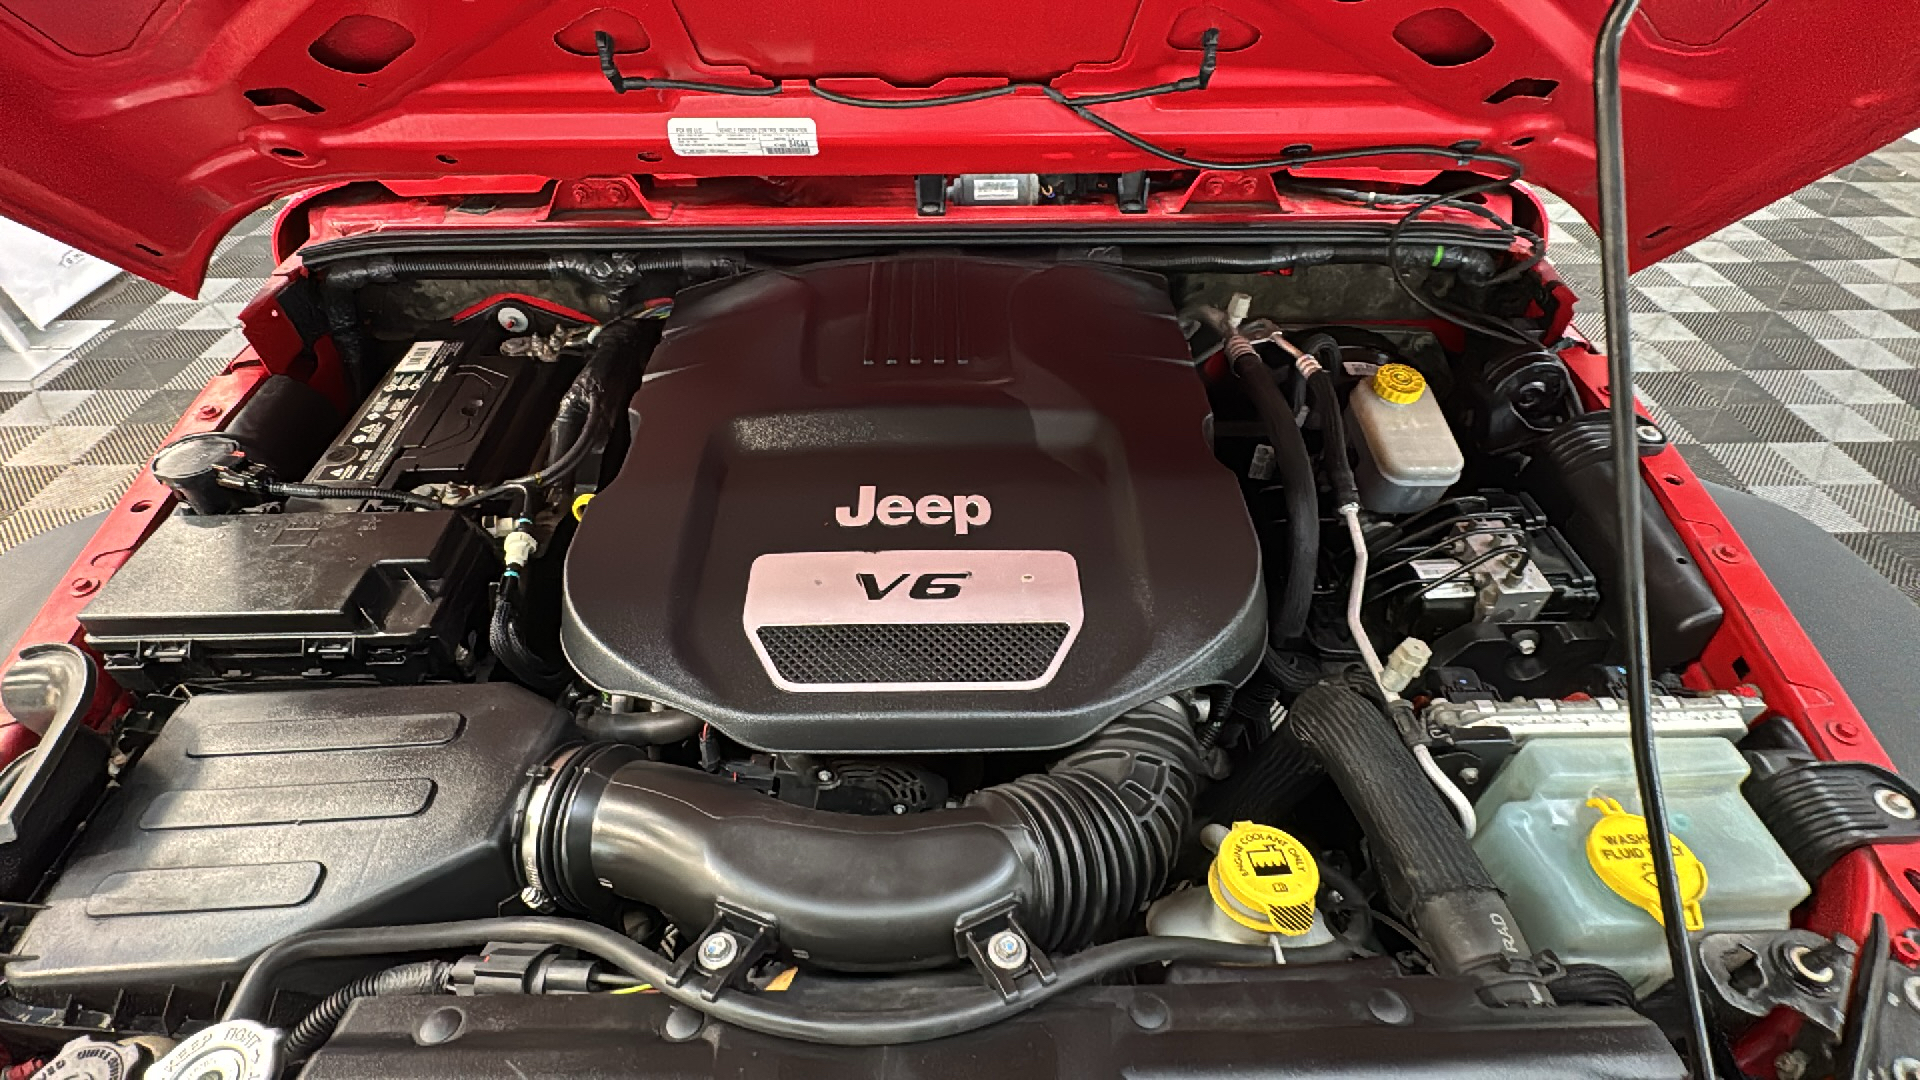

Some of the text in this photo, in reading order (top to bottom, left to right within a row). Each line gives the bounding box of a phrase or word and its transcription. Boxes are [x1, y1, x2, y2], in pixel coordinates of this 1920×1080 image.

[835, 485, 992, 535] Jeep
[855, 571, 973, 601] V6
[1240, 833, 1288, 847] COOLANT
[1288, 847, 1306, 872] ONLY
[1600, 847, 1645, 860] FLUID
[1490, 913, 1518, 953] RAD
